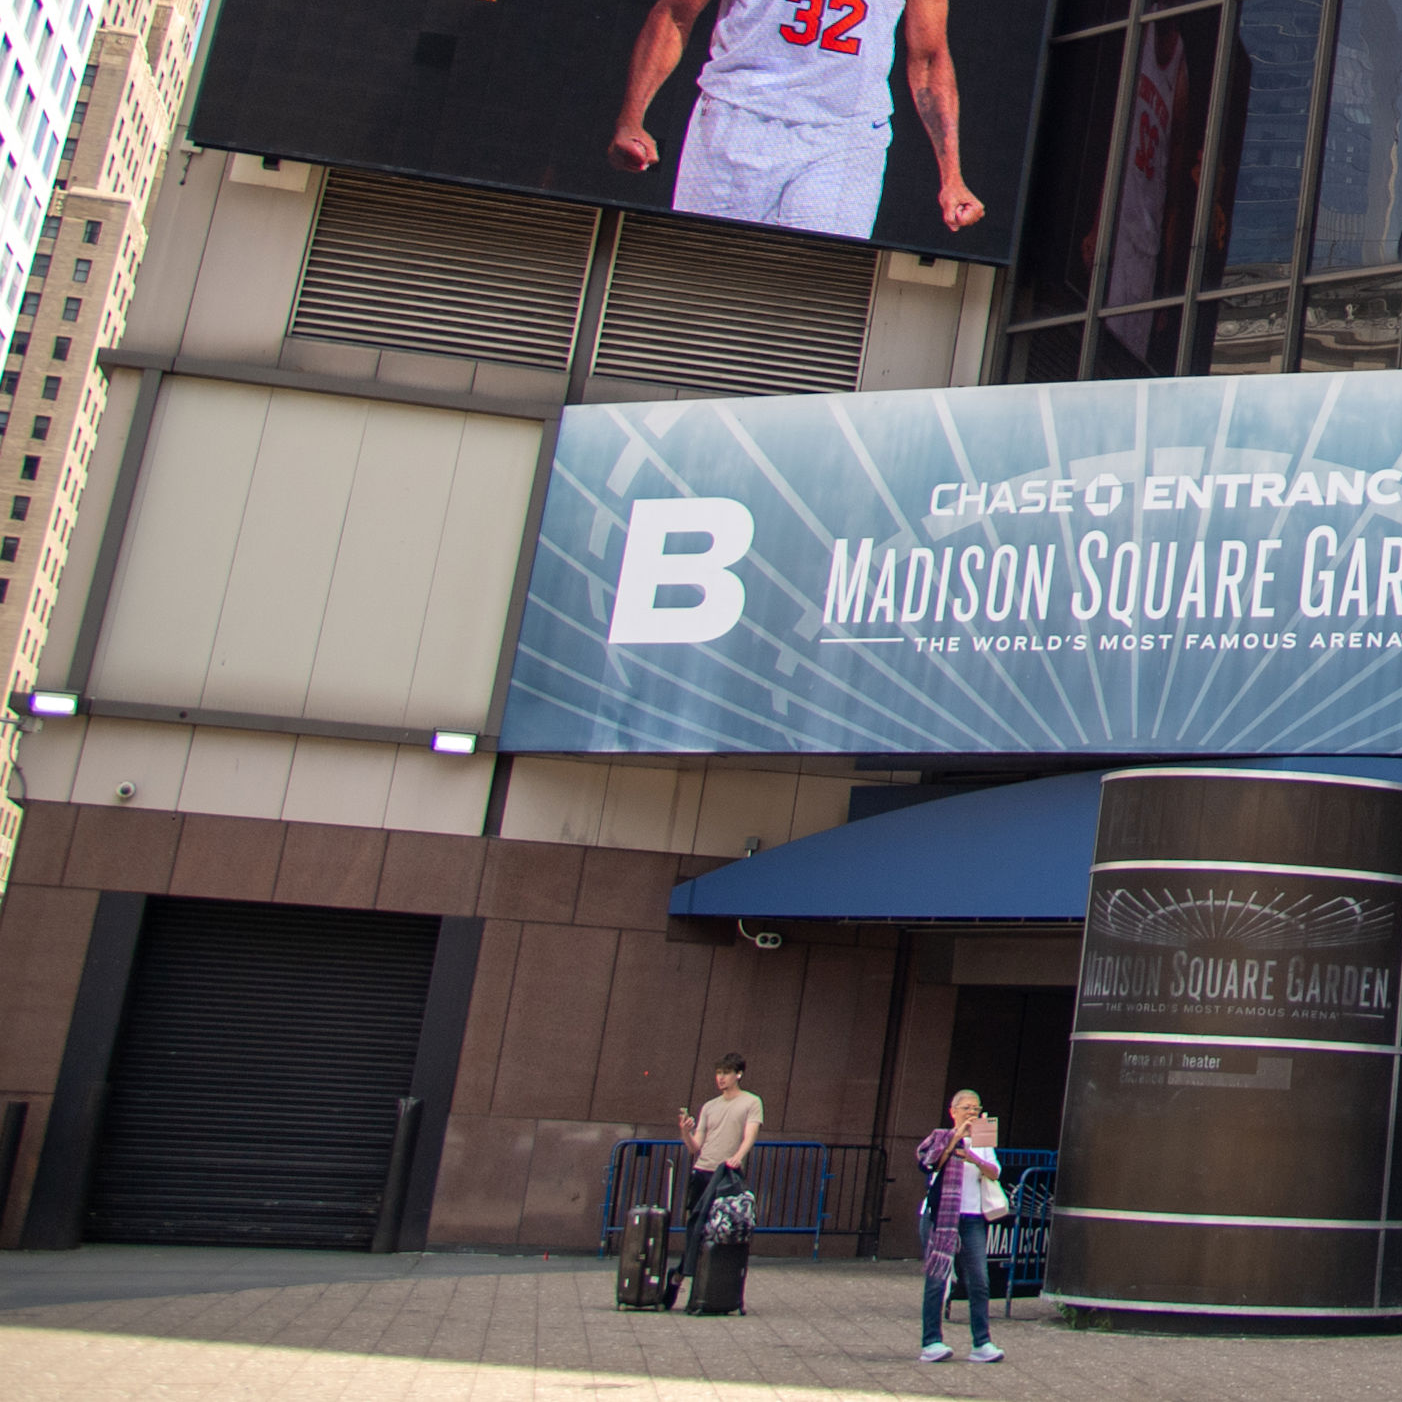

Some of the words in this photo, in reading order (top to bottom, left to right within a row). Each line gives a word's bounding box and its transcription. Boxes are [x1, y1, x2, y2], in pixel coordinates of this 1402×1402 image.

[930, 479, 1075, 516] CHASE
[608, 496, 755, 644] B
[823, 536, 1056, 625] MADISON
[1071, 529, 1283, 626] SQUARE
[914, 636, 960, 652] THE
[971, 634, 1088, 652] WORLD'S
[1099, 633, 1173, 651] MOST
[1185, 631, 1298, 650] FAMOUS
[1083, 951, 1162, 998] MADISON
[1169, 949, 1278, 1002] SQUARE
[1105, 1001, 1122, 1013] THE
[1183, 1003, 1221, 1015] MOST
[1226, 1005, 1286, 1018] FAMOUS
